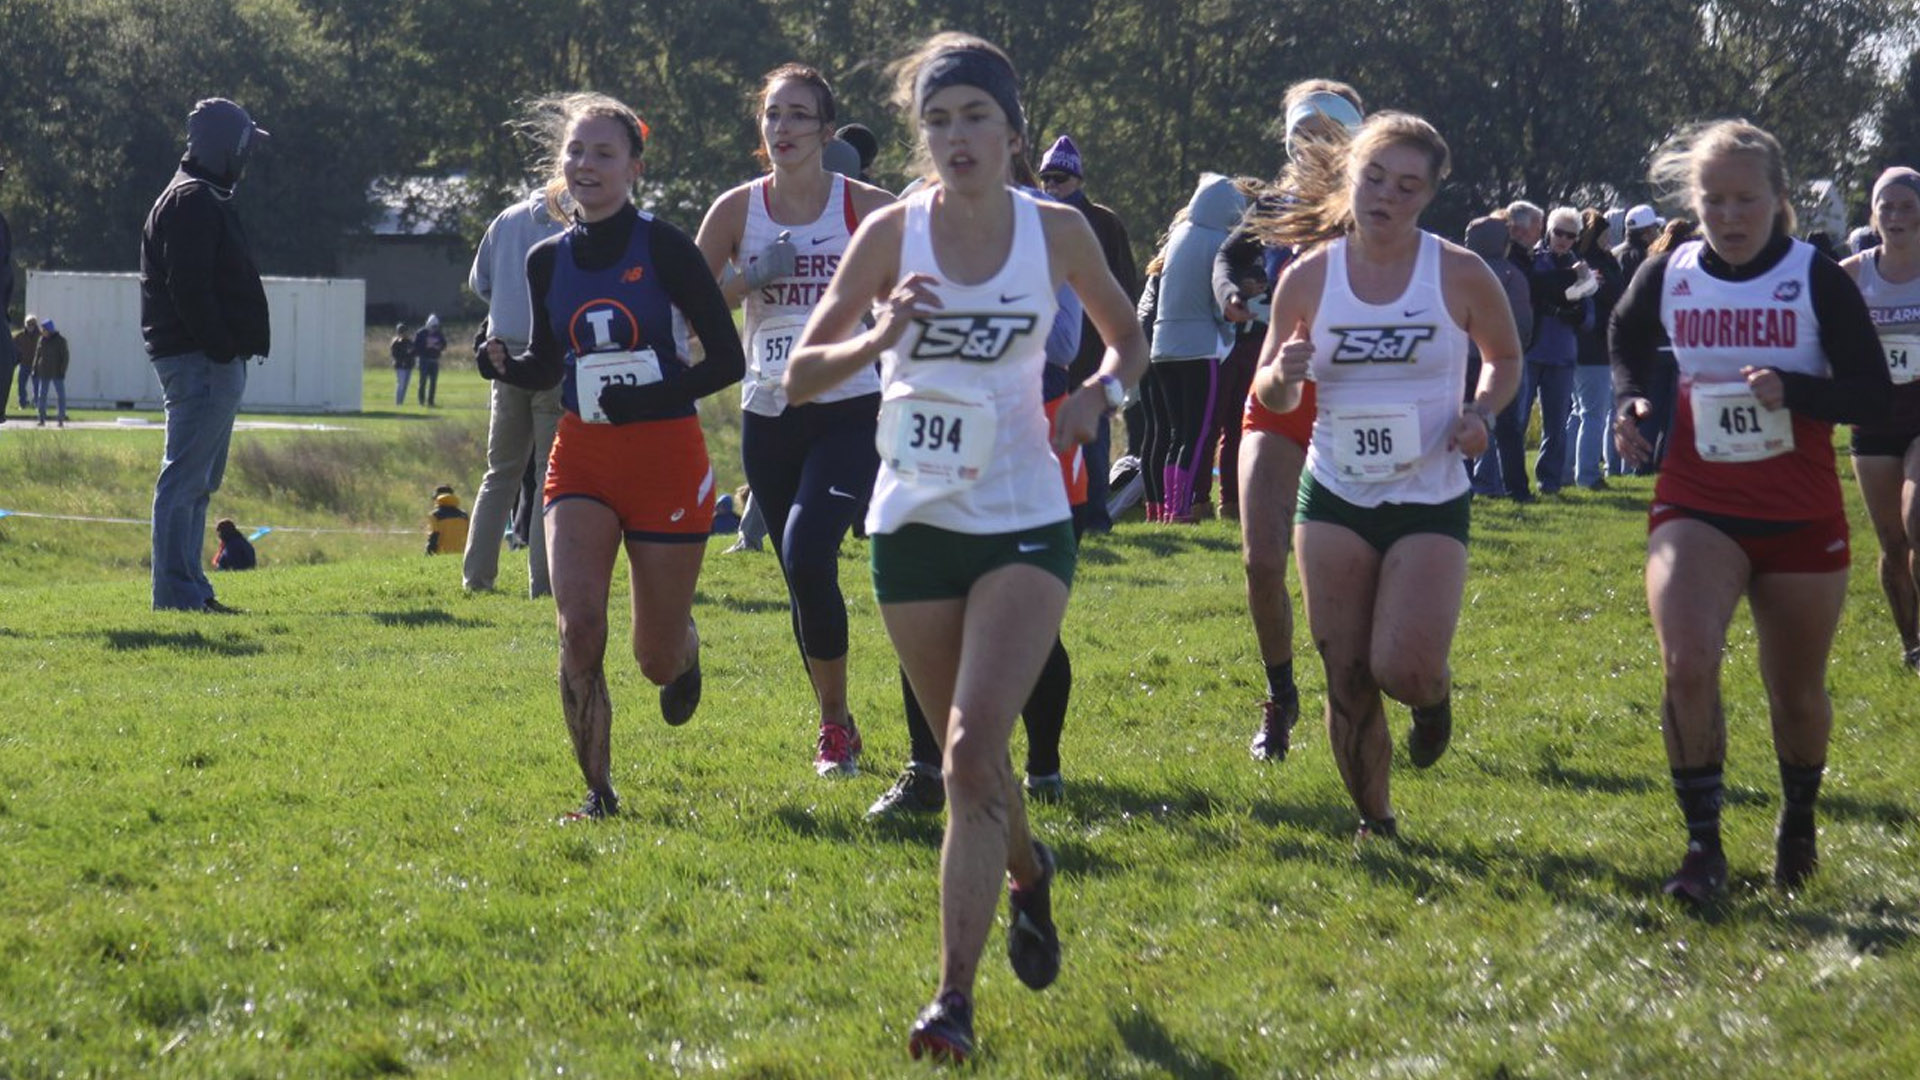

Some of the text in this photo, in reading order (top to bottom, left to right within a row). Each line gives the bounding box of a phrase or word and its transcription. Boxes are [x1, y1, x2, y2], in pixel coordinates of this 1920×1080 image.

[911, 314, 1039, 361] S&T
[1329, 325, 1438, 364] S&T
[1674, 308, 1797, 349] MOORHEAD
[765, 335, 793, 362] 557
[910, 413, 963, 453] 394
[1719, 406, 1763, 435] 461
[1354, 427, 1393, 457] 396
